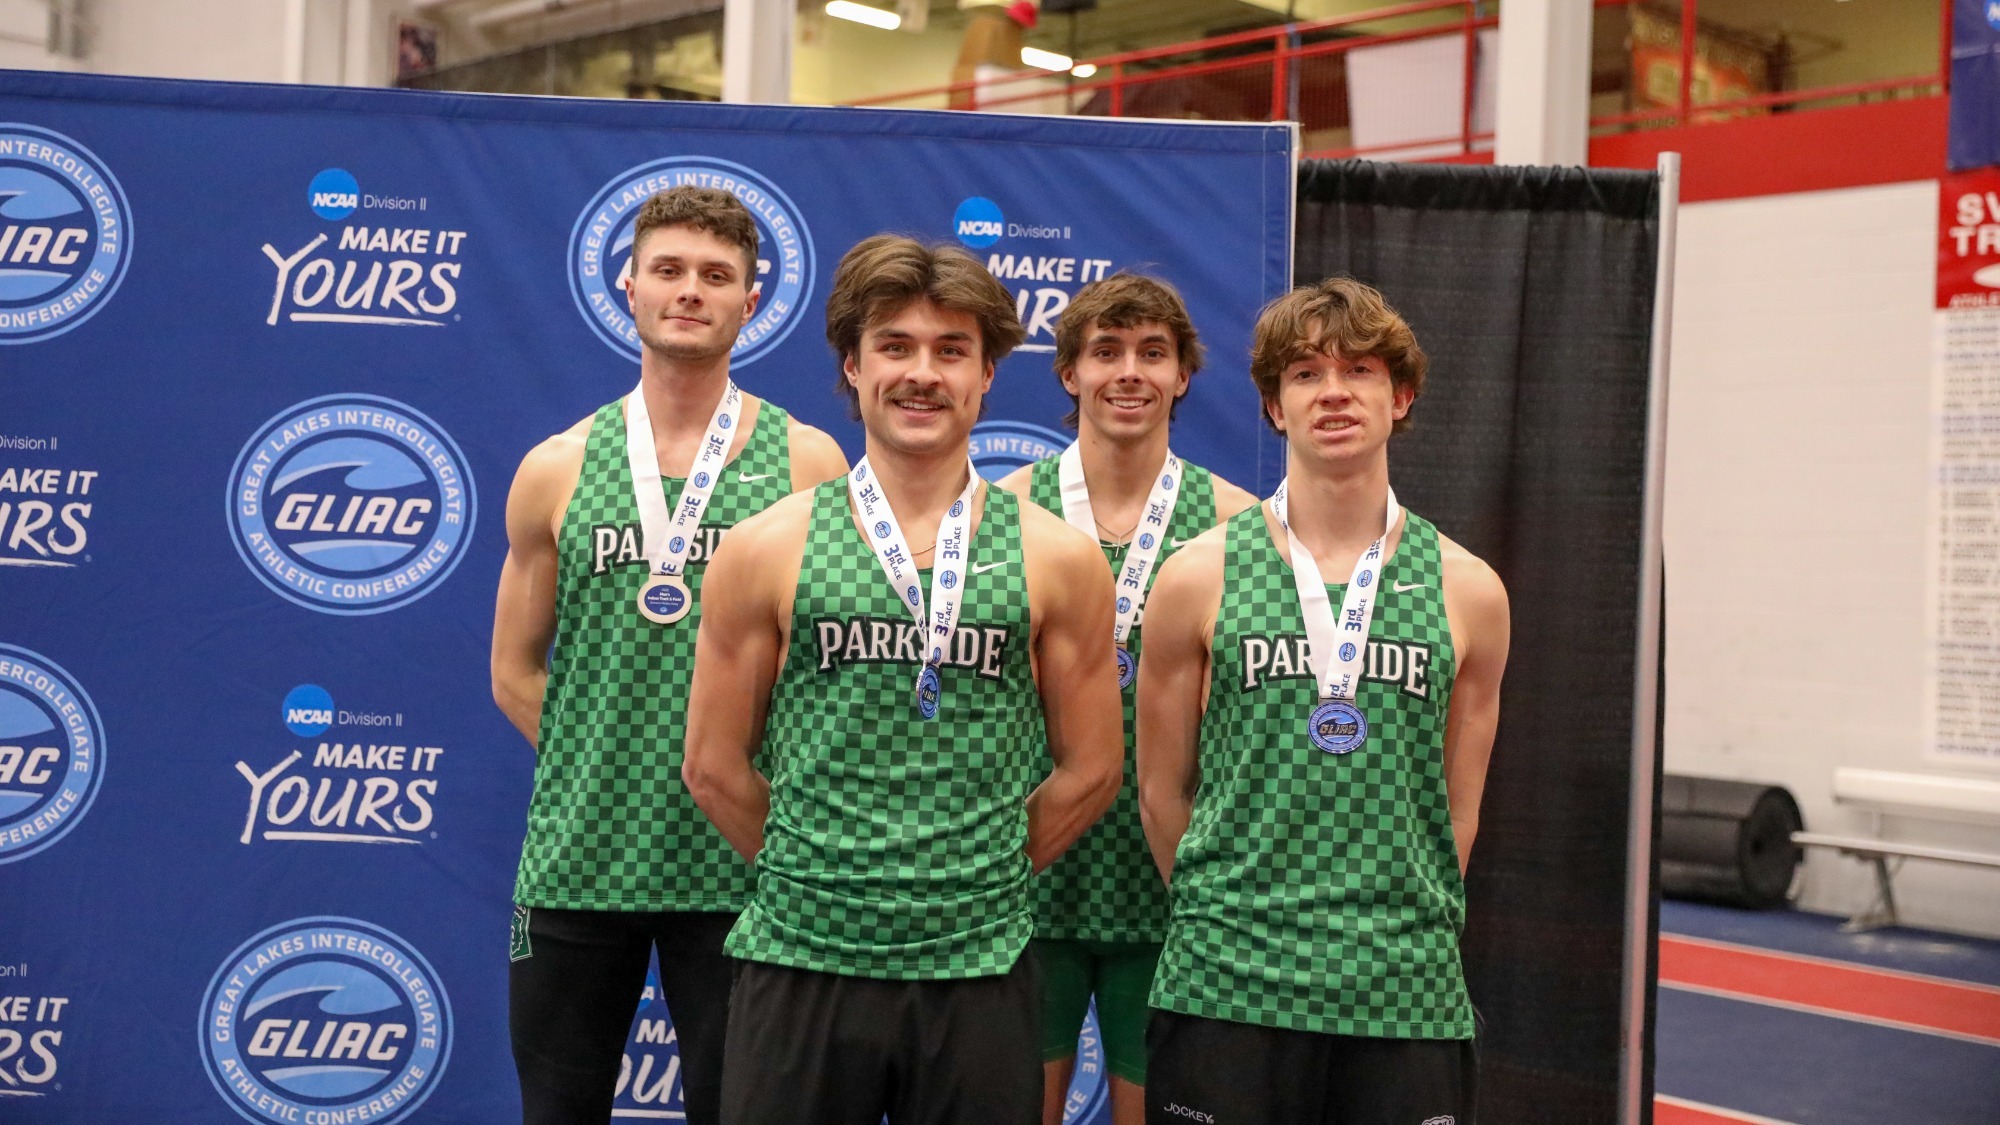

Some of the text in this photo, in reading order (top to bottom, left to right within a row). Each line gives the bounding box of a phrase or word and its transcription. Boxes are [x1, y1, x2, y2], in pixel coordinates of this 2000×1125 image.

[0, 140, 117, 254] NTERCOLLEGIATE
[313, 192, 358, 208] NCAA
[363, 194, 416, 211] Division
[338, 226, 467, 255] MAKE IT
[584, 213, 612, 277] GREAT
[610, 175, 670, 214] LAKES
[676, 173, 799, 285] INTERCOLLEGIATE
[957, 221, 1003, 236] NCAA
[1008, 224, 1060, 239] Division
[0, 225, 88, 265] IAC
[261, 233, 461, 326] YOURS
[986, 254, 1112, 283] MAKE IT
[0, 269, 105, 327] ONFERENCE
[590, 292, 643, 346] ATHLE
[0, 435, 46, 450] ivision
[702, 442, 714, 462] PLACE
[710, 434, 725, 457] 3rd
[243, 410, 461, 525] GREAT LAKES INTERCOLLEGIATE
[0, 468, 98, 495] AKE IT
[859, 483, 880, 504] 3rd
[274, 493, 433, 536] GLIAC
[677, 505, 687, 526] PLACE
[686, 496, 701, 518] 3rd
[863, 497, 874, 516] PLACE
[1147, 504, 1162, 526] 3rd
[1157, 498, 1168, 518] PLACE
[942, 539, 960, 560] 3rd
[953, 526, 962, 549] PLACE
[248, 531, 449, 599] ATHLETIC CONFERENCE
[883, 544, 907, 565] 3rd
[888, 556, 902, 580] PLACE
[1123, 567, 1139, 589] 3rd
[1135, 559, 1147, 580] PLACE
[945, 601, 954, 626] PLACE
[1345, 609, 1362, 632] 3rd
[1356, 599, 1367, 622] PLACE
[934, 611, 949, 637] 3rd
[1115, 624, 1123, 641] LACE
[817, 621, 1007, 677] PARKDE
[1244, 639, 1430, 697] PARIDE
[1340, 673, 1351, 697] PLACE
[0, 661, 90, 773] ERCOLLEGIATE
[287, 709, 333, 725] NCAA
[338, 711, 391, 726] Division
[313, 743, 444, 771] MAKE IT
[235, 750, 438, 845] YOURS
[0, 788, 78, 847] FERENCE
[215, 933, 436, 1050] GREAT LAKES INTERCOLLEGIATE
[36, 997, 69, 1022] IT
[247, 1018, 407, 1061] GLIAC
[221, 1057, 425, 1125] ATHLETIC CONFERENCE
